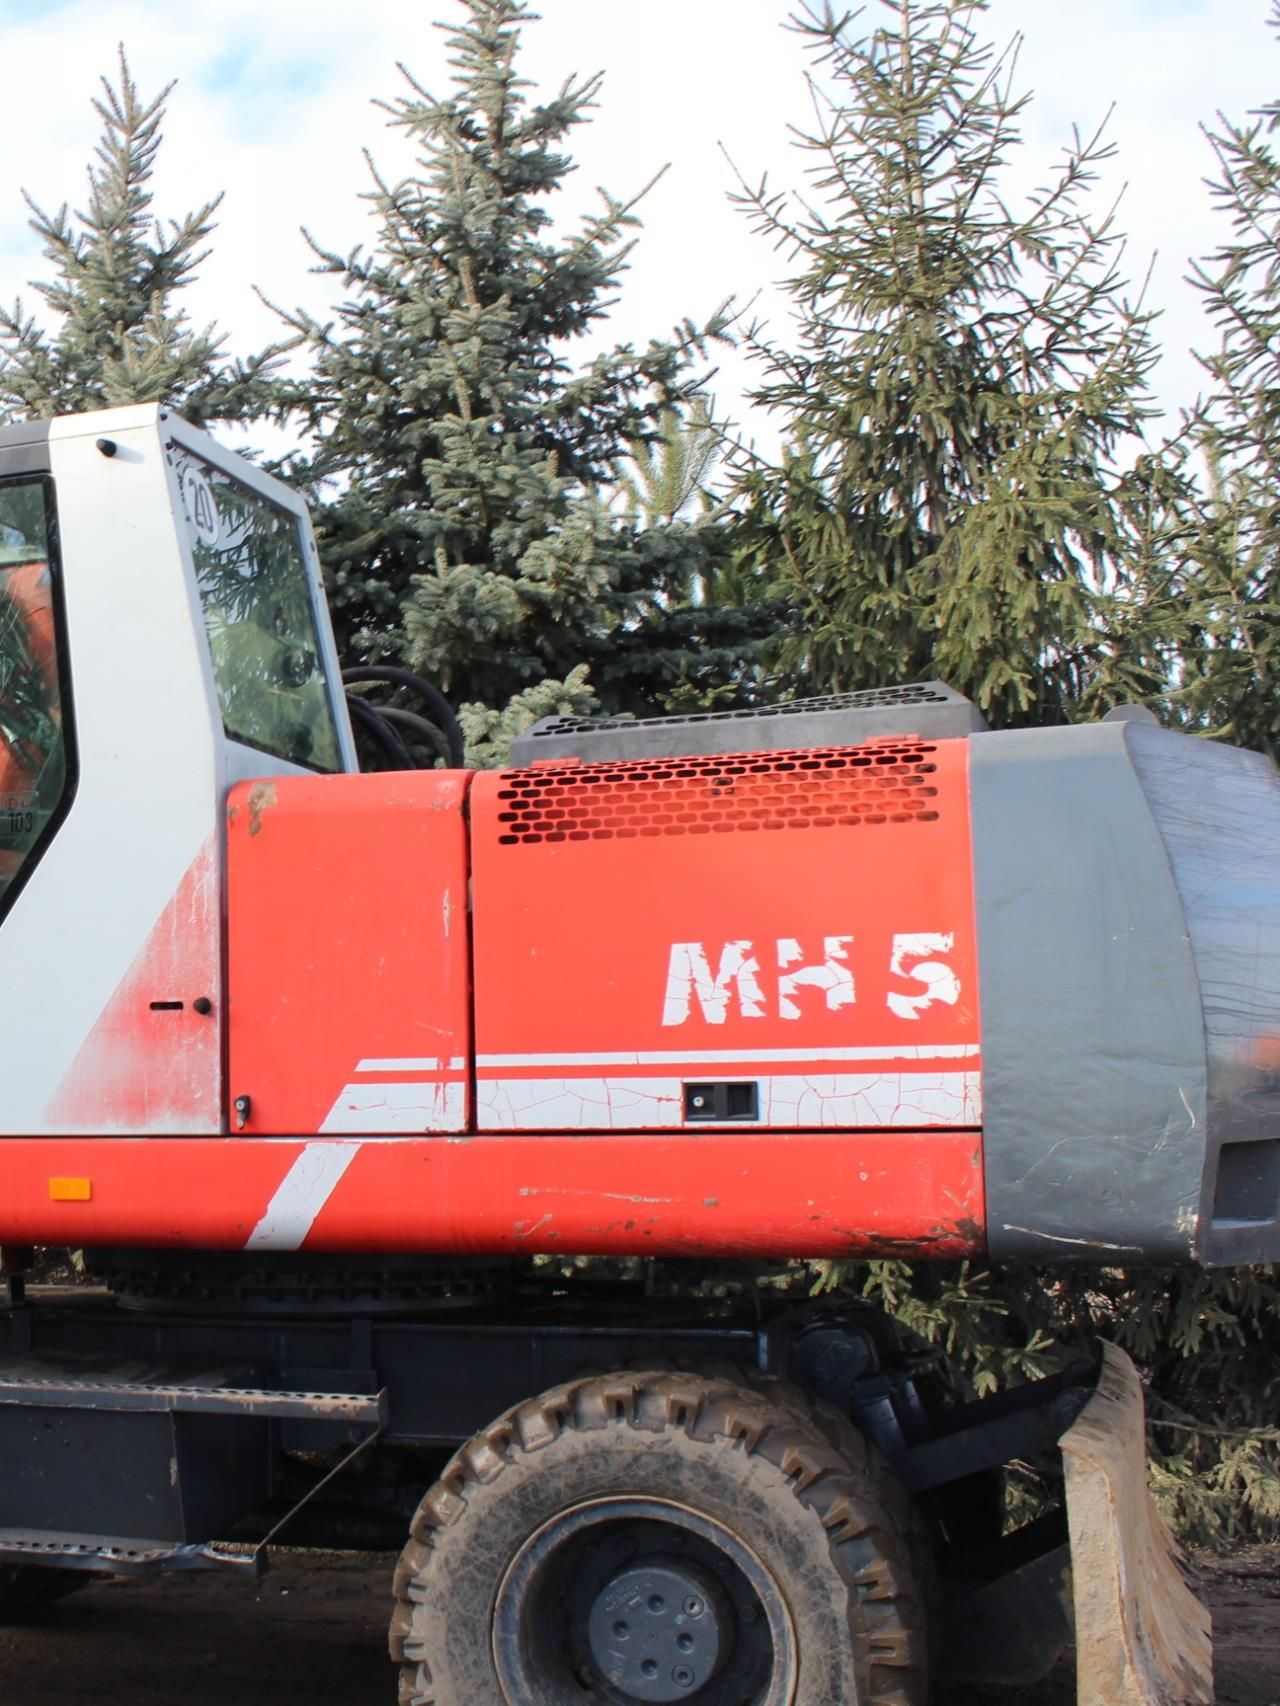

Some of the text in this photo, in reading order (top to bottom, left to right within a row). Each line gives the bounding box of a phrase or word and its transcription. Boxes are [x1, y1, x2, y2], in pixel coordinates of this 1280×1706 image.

[188, 477, 214, 533] 20
[8, 812, 34, 833] 103
[662, 932, 961, 1026] MH 5
